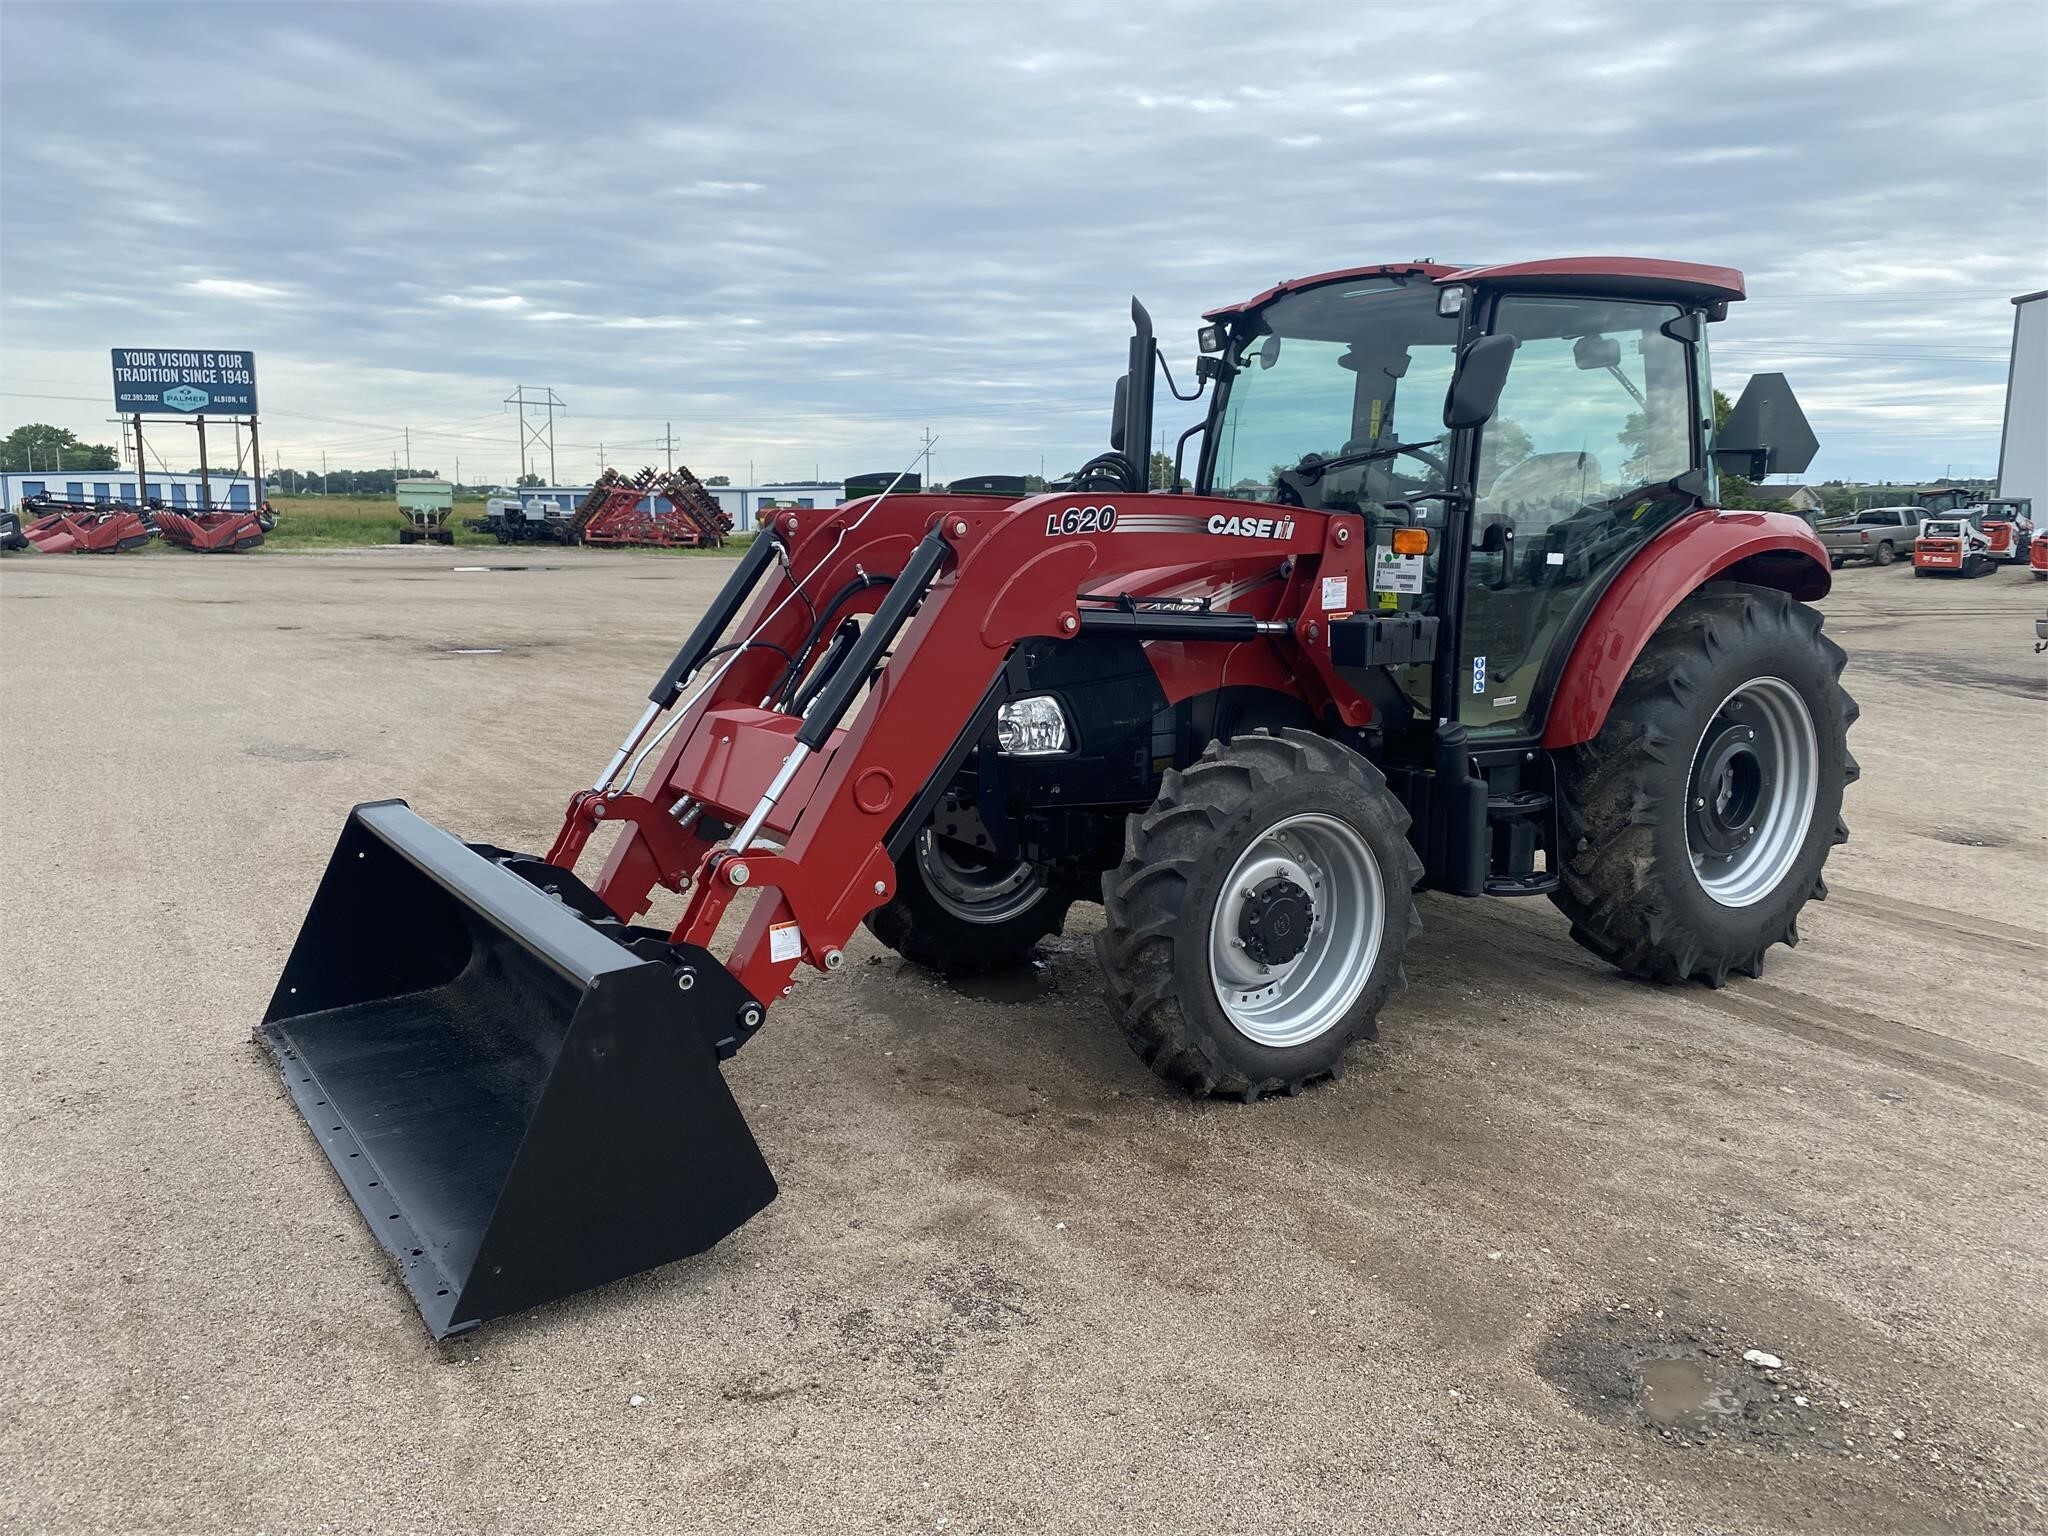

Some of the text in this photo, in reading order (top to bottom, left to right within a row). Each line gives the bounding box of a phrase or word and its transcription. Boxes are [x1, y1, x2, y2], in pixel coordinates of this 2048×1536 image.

[124, 352, 243, 369] YOUR VISION IS OUR
[116, 368, 254, 385] TRADITION SINCE 1949.
[1046, 505, 1117, 537] L620
[1207, 514, 1271, 538] CASE
